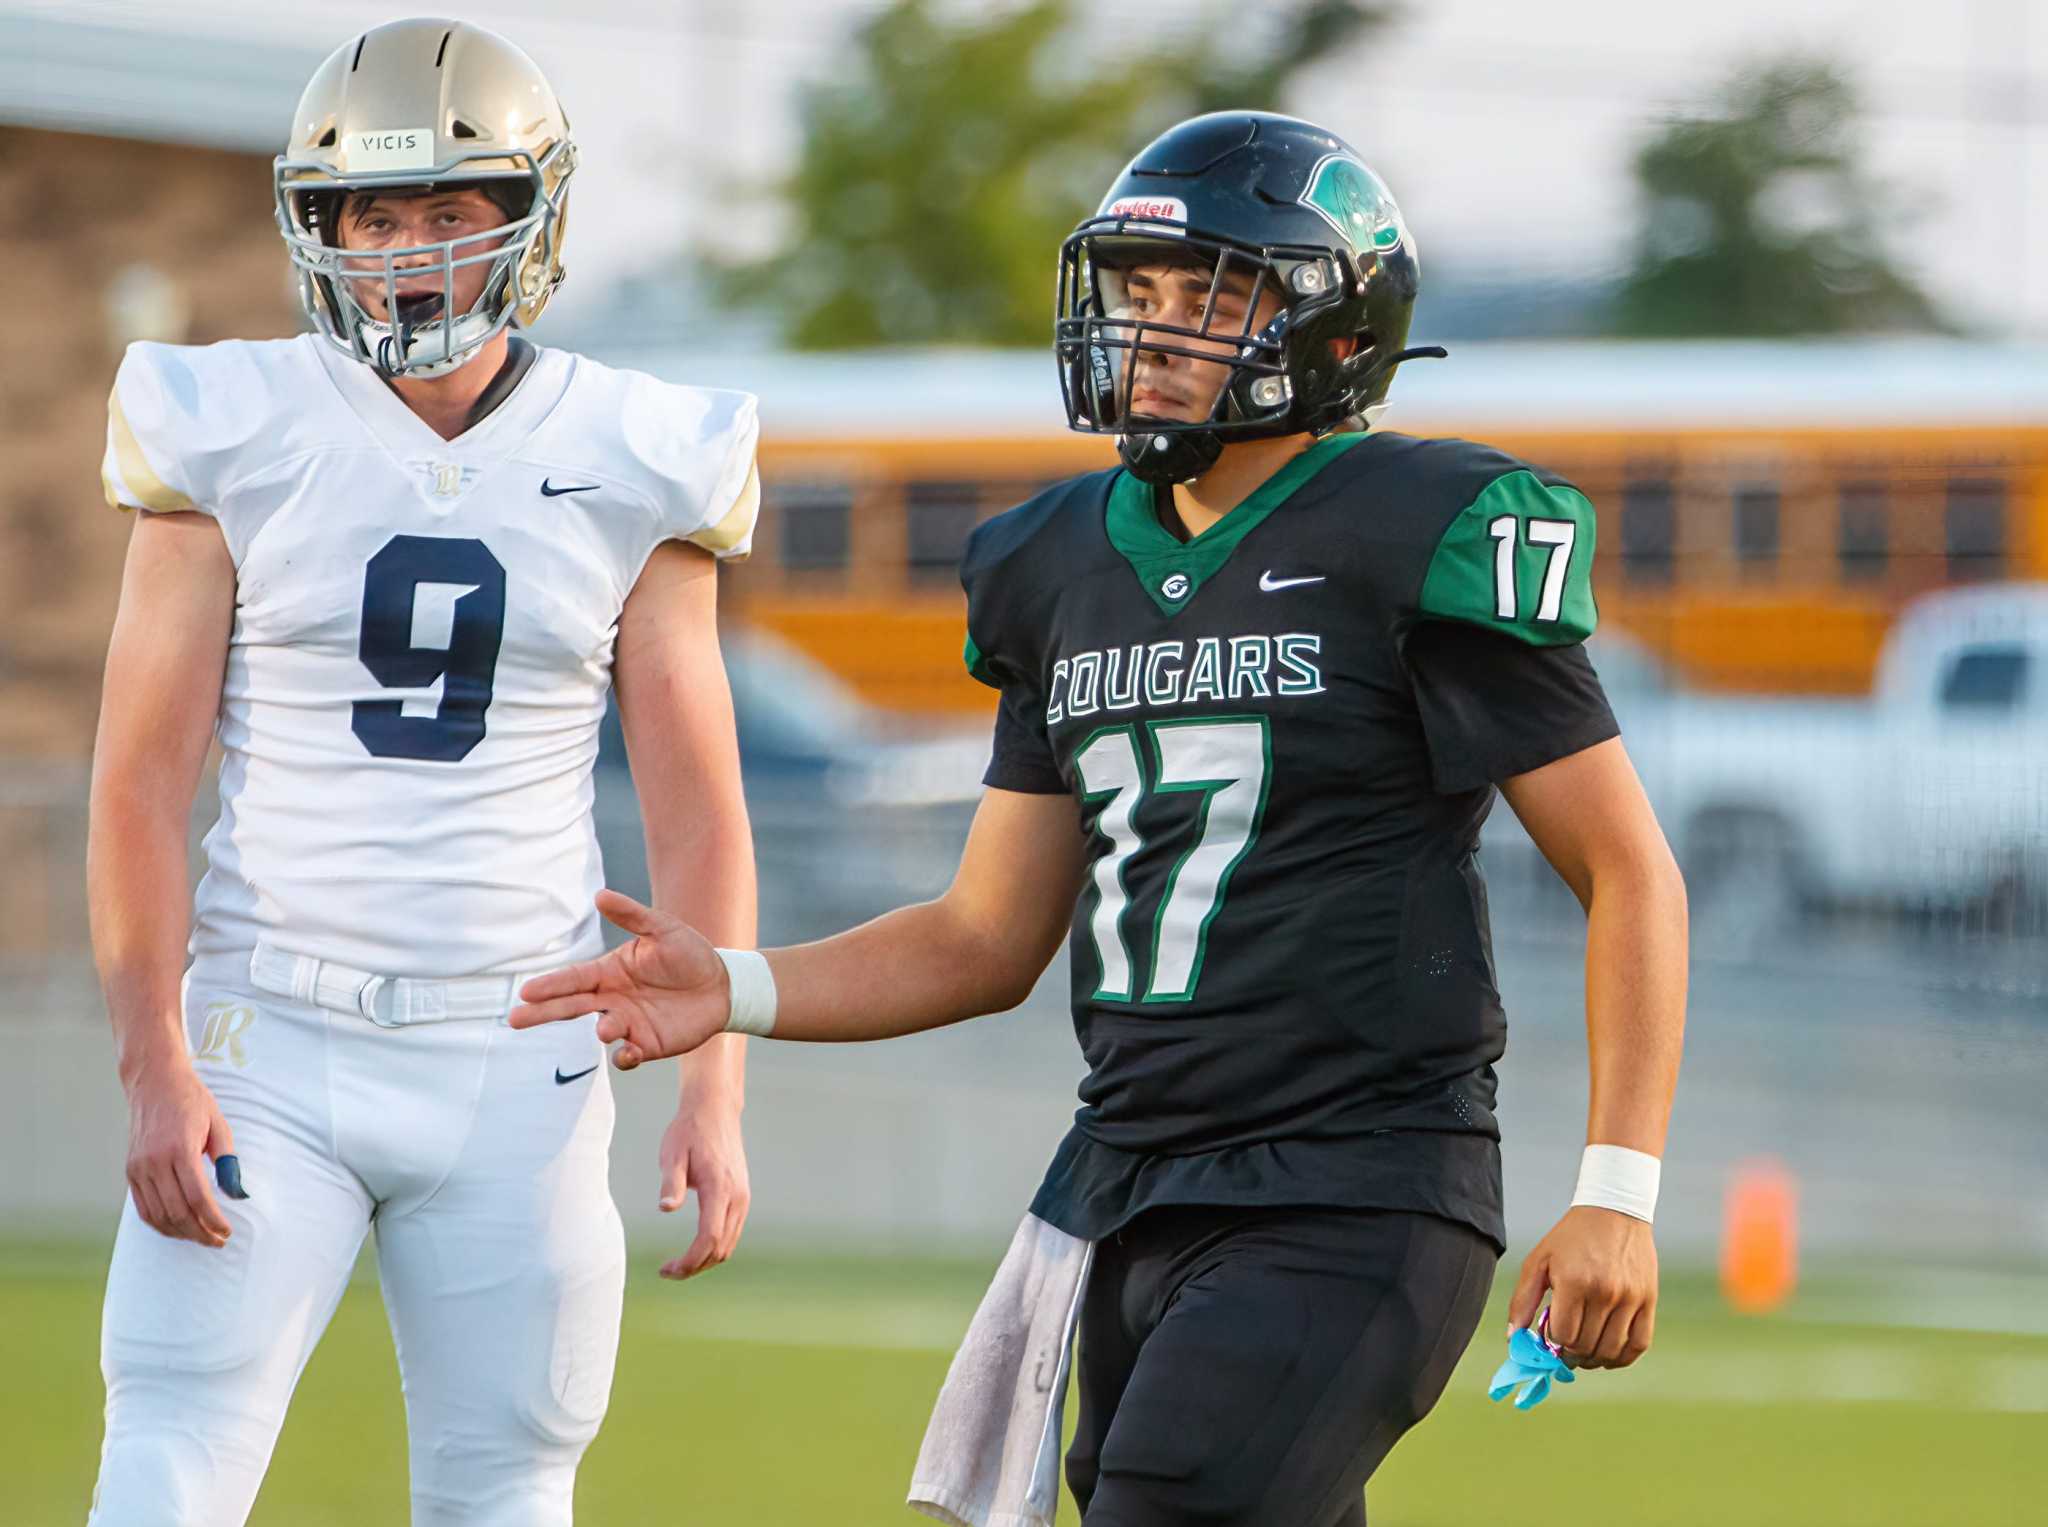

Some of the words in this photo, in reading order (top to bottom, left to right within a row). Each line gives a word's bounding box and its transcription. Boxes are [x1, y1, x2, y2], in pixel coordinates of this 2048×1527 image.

[361, 135, 416, 151] VICIS
[1487, 513, 1576, 624] 17
[351, 534, 507, 763] 9
[1046, 633, 1327, 725] COUGARS
[1072, 713, 1273, 1004] 17
